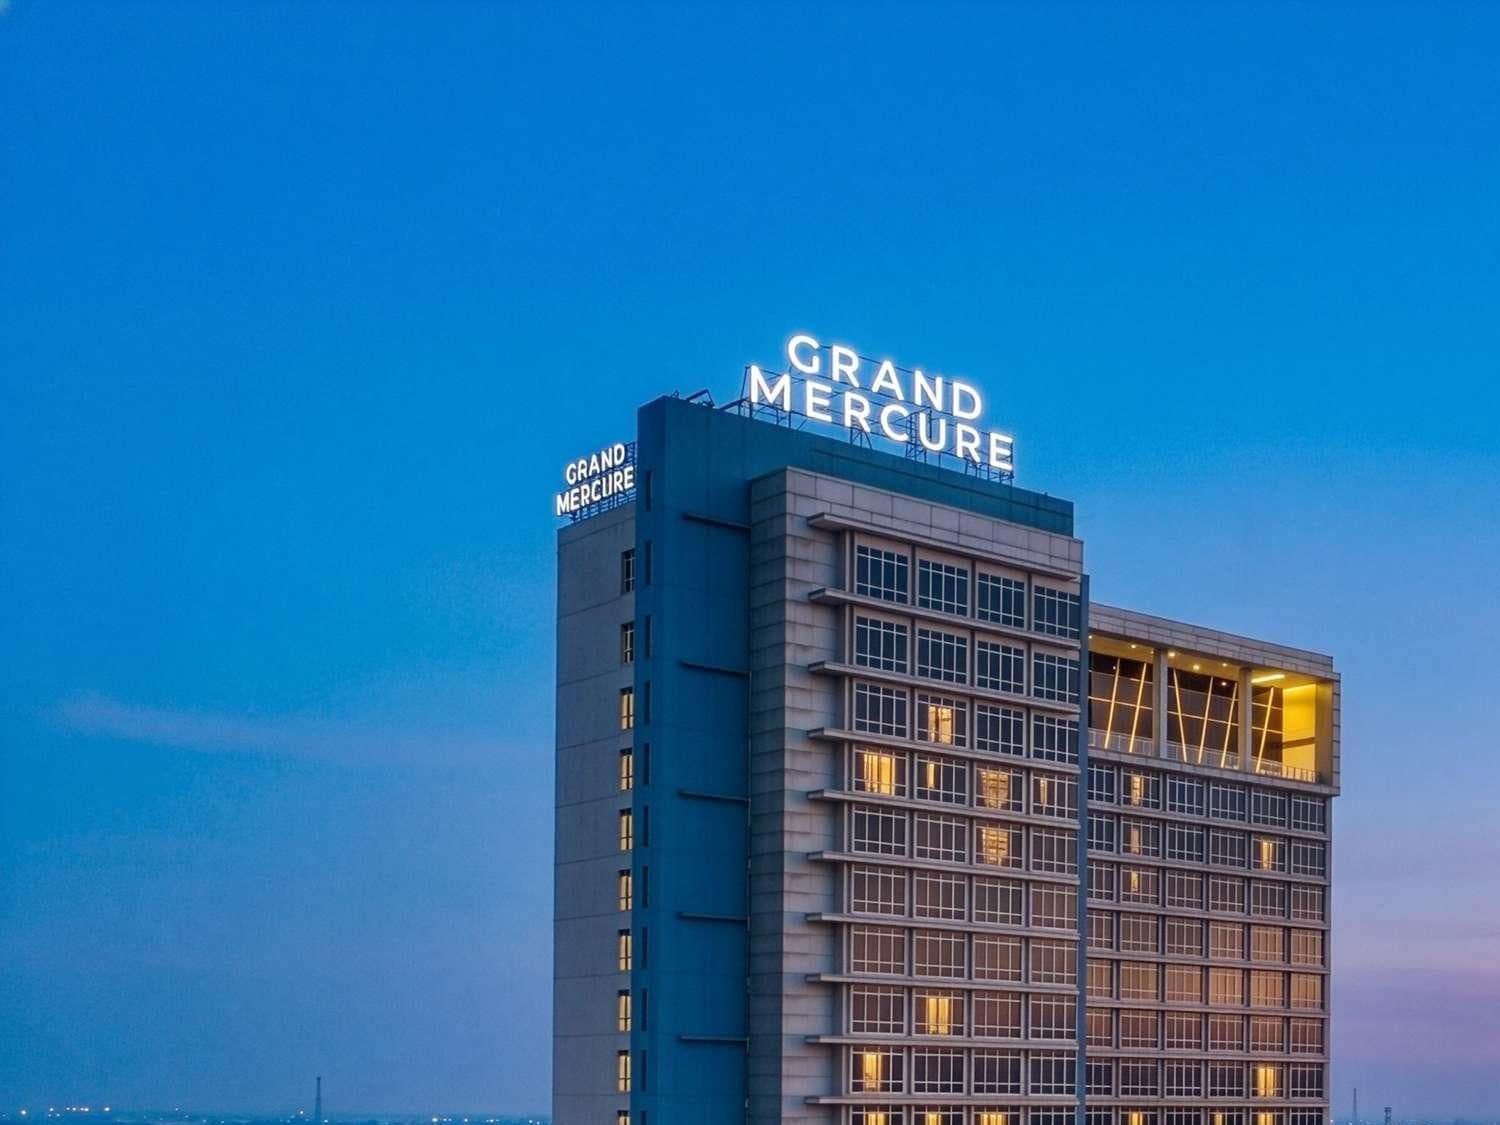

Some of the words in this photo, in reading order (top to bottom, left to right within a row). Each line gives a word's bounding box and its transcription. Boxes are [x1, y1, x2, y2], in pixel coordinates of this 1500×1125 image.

[787, 334, 983, 421] GRAND
[749, 364, 1015, 473] MERCURE
[556, 466, 634, 516] MERCURE
[566, 443, 625, 485] GRAND
